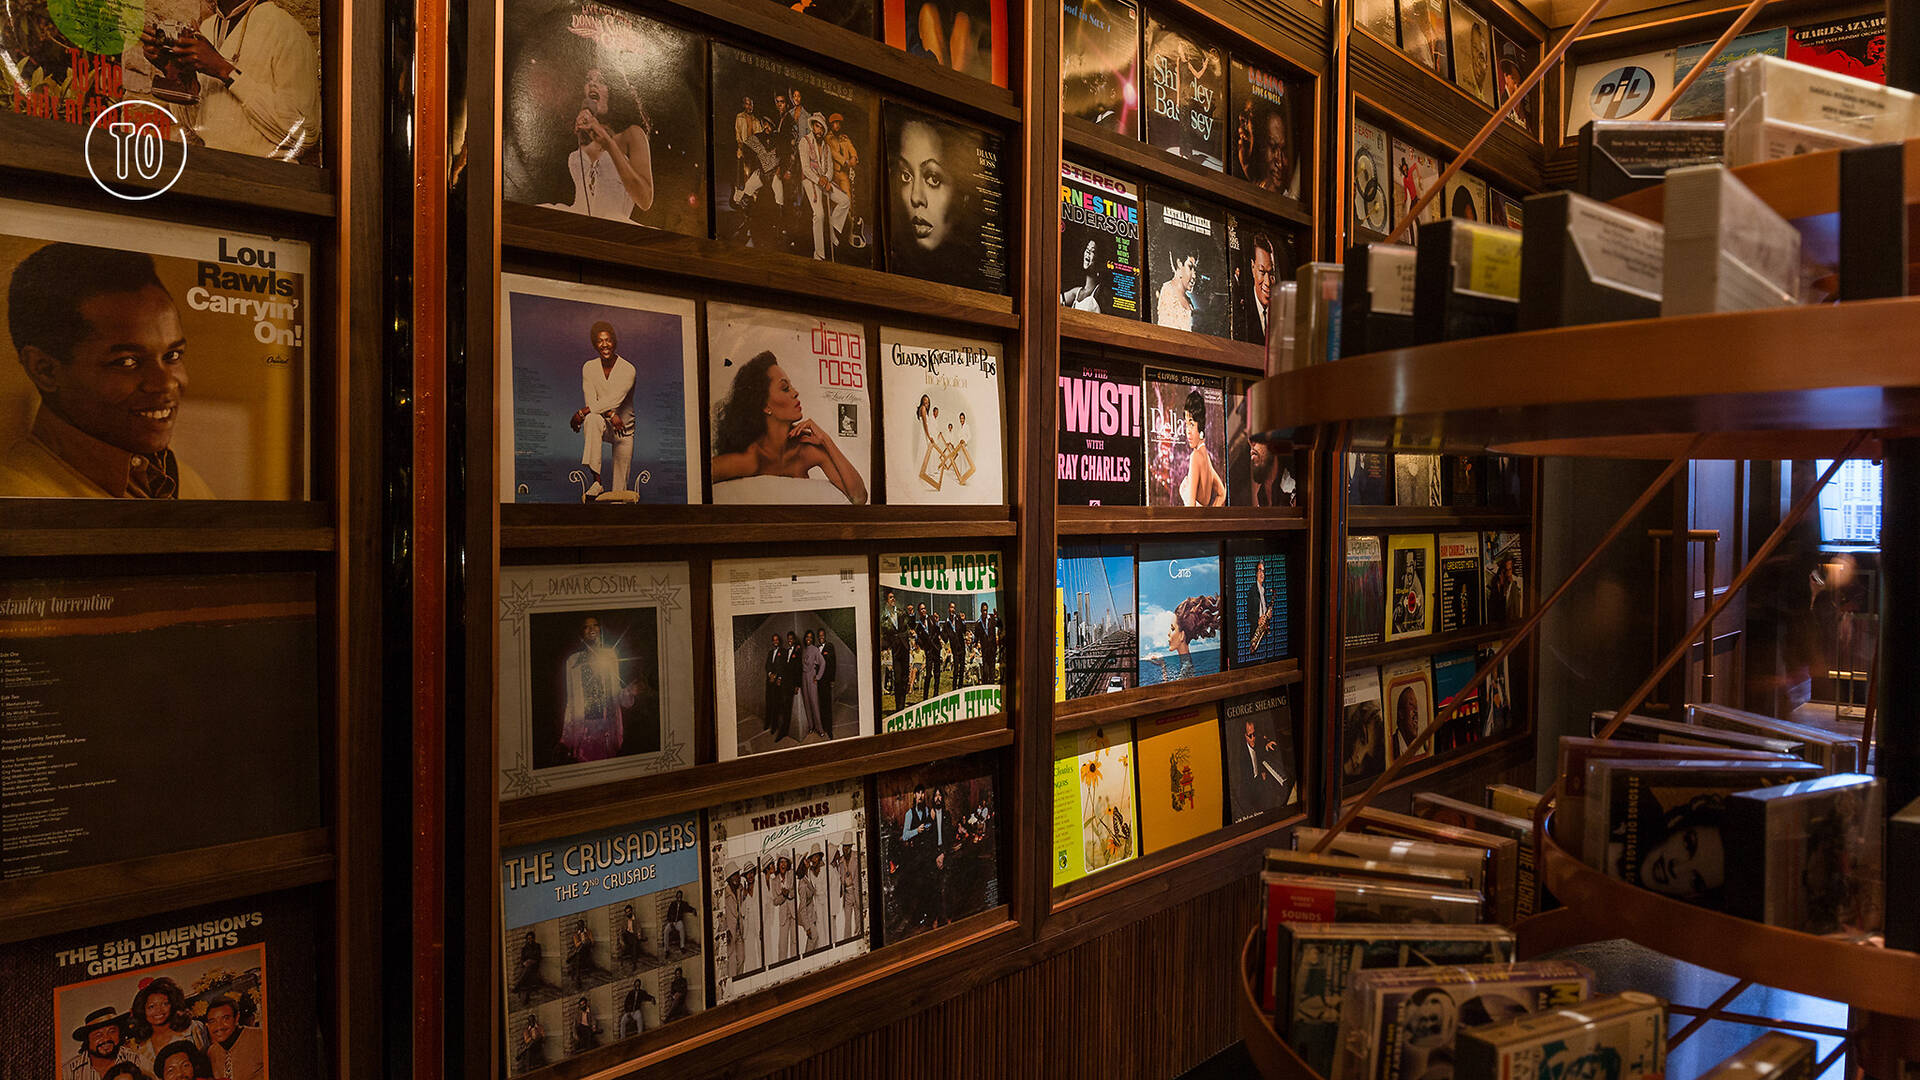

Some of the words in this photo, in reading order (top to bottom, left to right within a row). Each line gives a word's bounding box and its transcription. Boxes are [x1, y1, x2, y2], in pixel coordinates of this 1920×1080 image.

[1795, 24, 1845, 41] CHARLES
[67, 47, 89, 92] To
[94, 54, 123, 99] the
[1594, 78, 1641, 105] PiL
[979, 157, 996, 169] ROSS
[1062, 163, 1127, 194] STEREO
[218, 237, 276, 269] Lou
[197, 261, 294, 297] Rawls
[186, 286, 299, 322] Carryin'
[254, 321, 302, 347] On!
[812, 321, 861, 360] diana
[819, 358, 863, 388] ross
[957, 355, 964, 365] &
[1082, 367, 1093, 377] DO
[1094, 368, 1108, 380] THE
[1150, 407, 1186, 437] Della
[1086, 439, 1105, 450] WITH
[1057, 453, 1079, 481] RAY
[1080, 454, 1131, 482] CHARLES
[548, 577, 580, 596] DIANA
[583, 575, 619, 595] ROSS
[619, 575, 638, 593] LIVE
[900, 555, 949, 590] FOUR
[952, 553, 999, 591] TOPS
[887, 693, 961, 734] GREATEST
[964, 688, 1002, 719] HITS
[1226, 702, 1254, 719] GEORGE
[1254, 696, 1287, 713] SHEARING
[751, 814, 777, 831] THE
[778, 801, 830, 826] STAPLES
[504, 850, 555, 890] THE
[562, 819, 697, 876] CRUSADERS
[554, 881, 580, 903] THE
[602, 863, 657, 891] CRUSADE
[1281, 909, 1322, 921] SOUNDS
[55, 943, 99, 968] THE
[103, 936, 136, 957] 5th
[140, 911, 263, 948] DIMENSION'S
[87, 940, 196, 977] GREATEST
[196, 931, 238, 953] HITS
